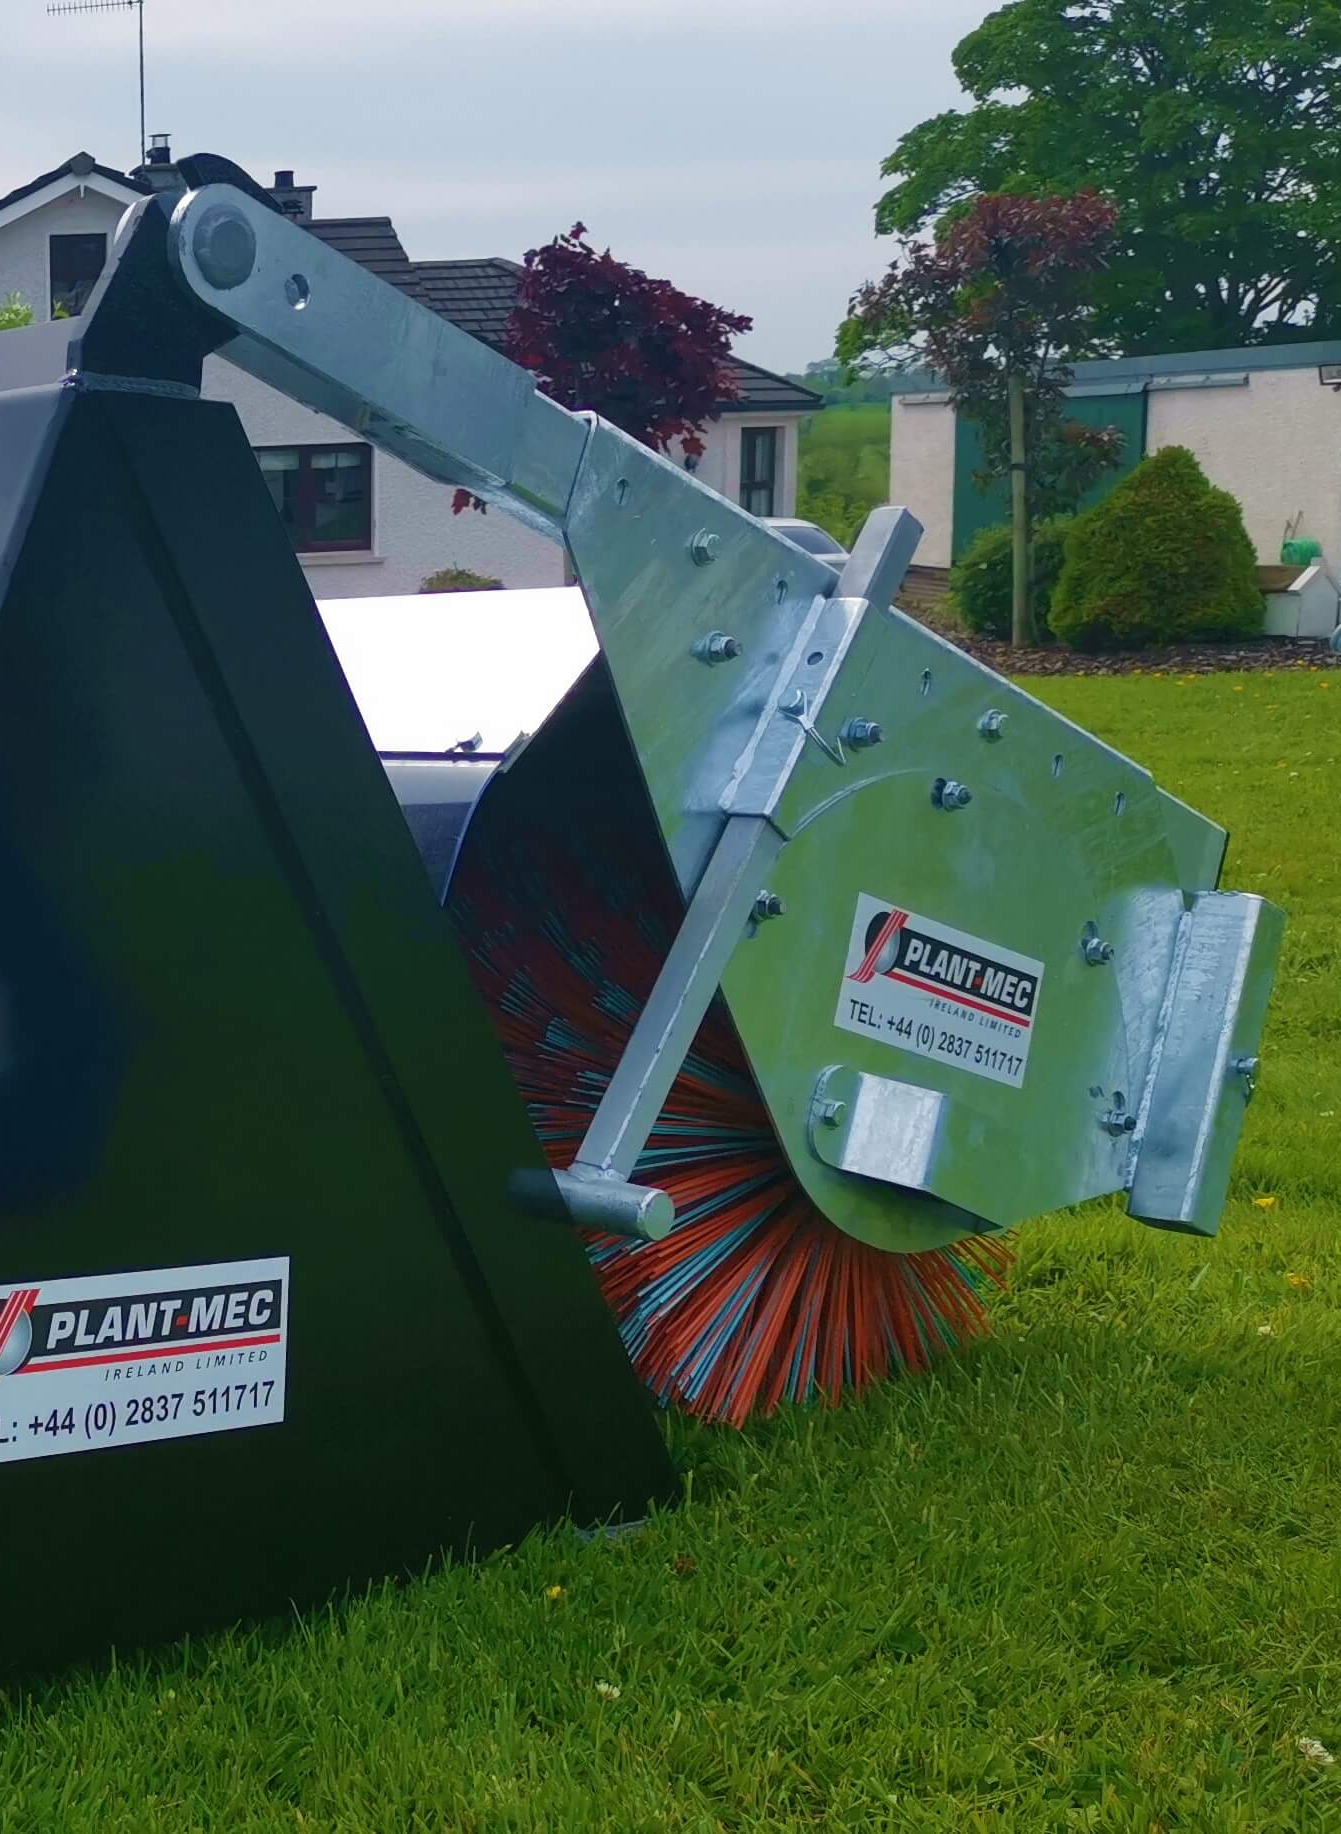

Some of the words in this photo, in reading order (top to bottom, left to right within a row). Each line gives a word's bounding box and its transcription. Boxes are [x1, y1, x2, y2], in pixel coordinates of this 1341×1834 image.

[850, 999, 882, 1029] TEL:
[887, 1016, 914, 1039] +44
[916, 1023, 935, 1052] (0)
[938, 1031, 972, 1059] 2837
[974, 1044, 1023, 1077] 511717
[929, 998, 975, 1022] IRELAND
[979, 1018, 1022, 1039] LIMITED
[105, 1360, 185, 1382] IRELAND
[196, 1350, 268, 1370] LIMITED
[28, 1407, 76, 1437] +44
[84, 1401, 117, 1440] (0)
[125, 1392, 184, 1426] 2837
[193, 1380, 275, 1416] 511717
